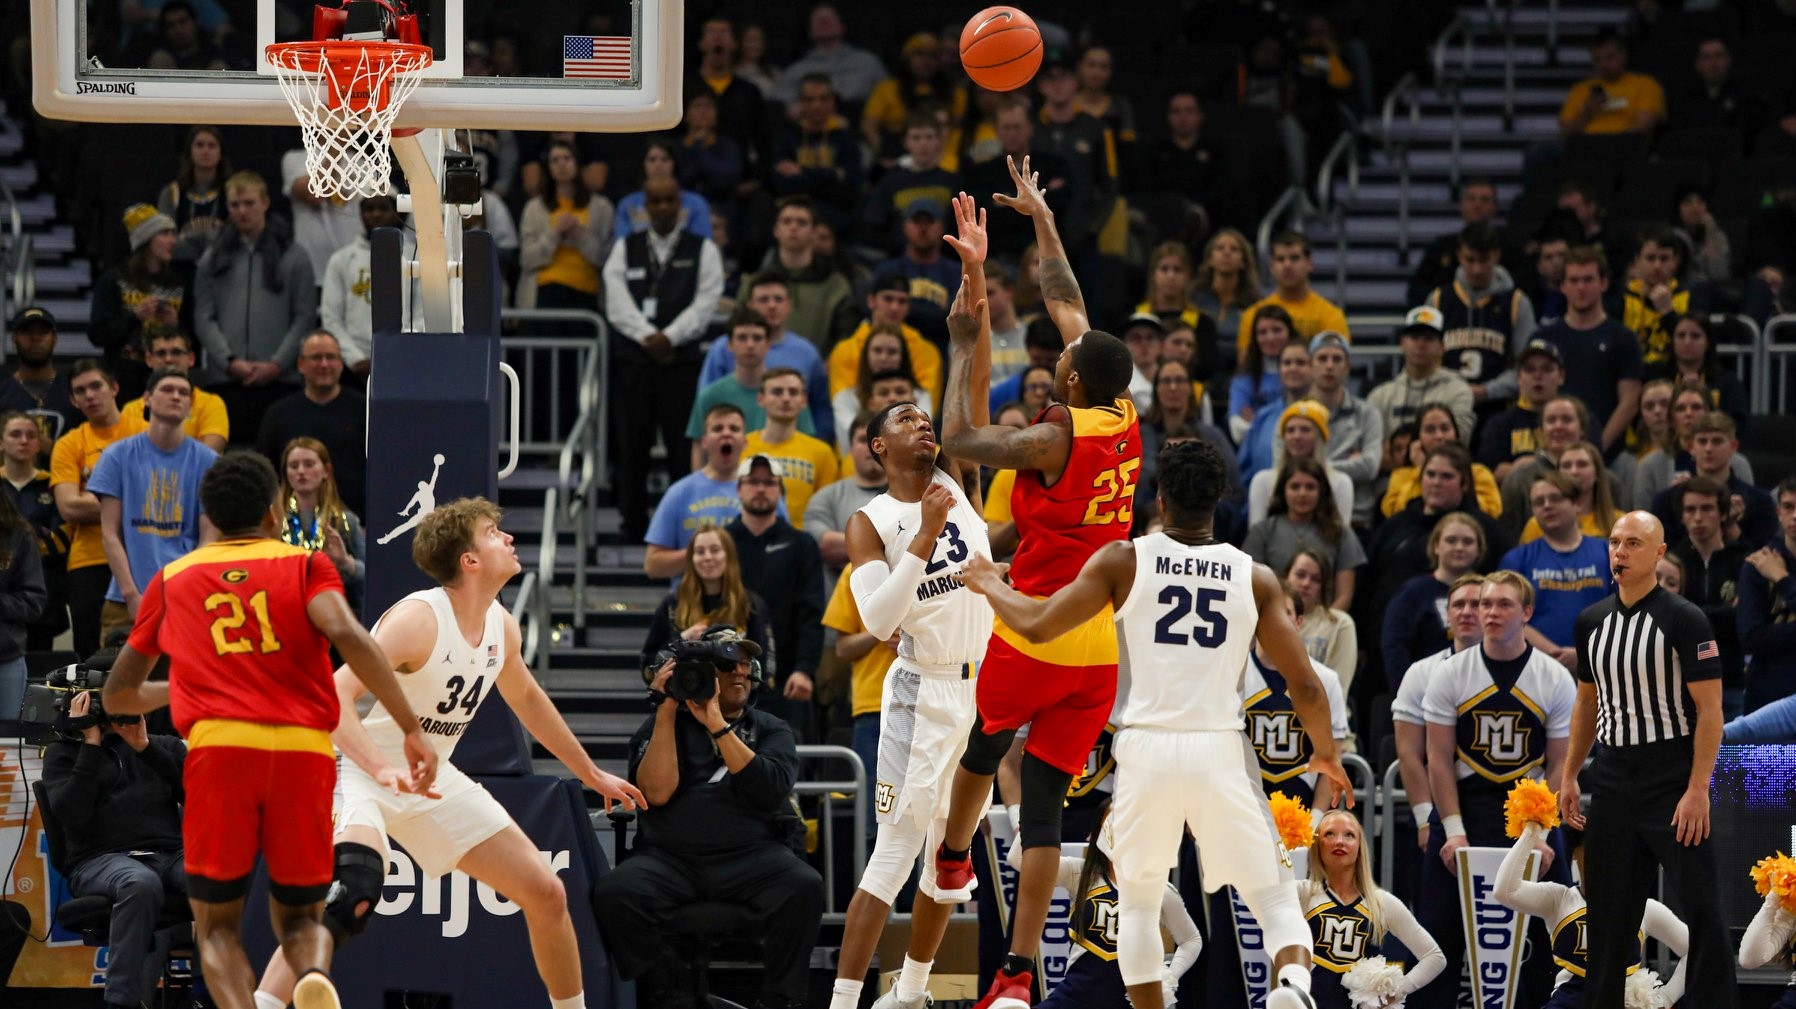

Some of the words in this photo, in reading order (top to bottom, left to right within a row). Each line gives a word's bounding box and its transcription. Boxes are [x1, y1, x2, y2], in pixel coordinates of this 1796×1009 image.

[76, 81, 135, 95] SPALDING
[1459, 349, 1483, 380] 3
[1081, 457, 1140, 525] 25
[925, 521, 969, 576] 23
[1155, 556, 1232, 581] McEWEN
[204, 590, 281, 656] 21
[1154, 585, 1228, 649] 25
[436, 675, 484, 716] 34
[1472, 711, 1531, 765] MU
[876, 782, 896, 813] MU
[374, 848, 570, 938] eijer
[1472, 874, 1514, 950] OUT
[1315, 913, 1369, 963] MU
